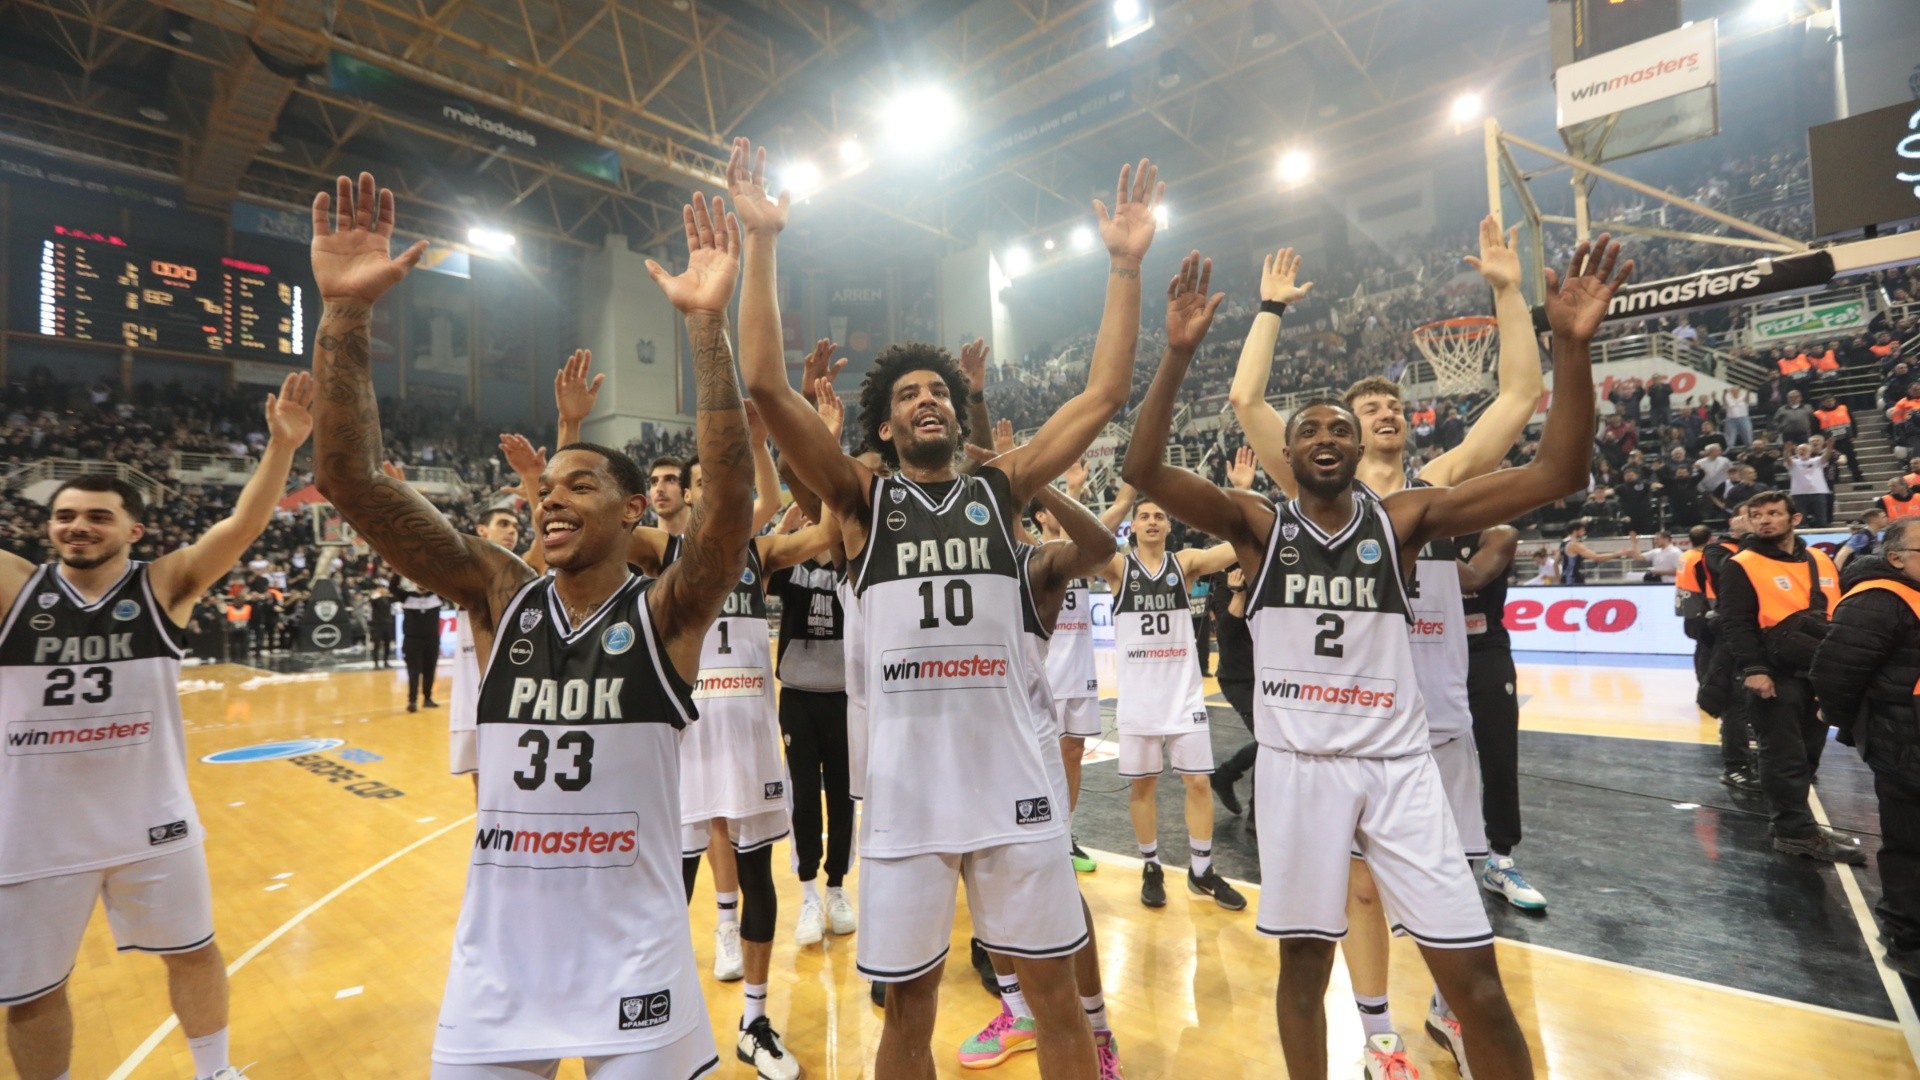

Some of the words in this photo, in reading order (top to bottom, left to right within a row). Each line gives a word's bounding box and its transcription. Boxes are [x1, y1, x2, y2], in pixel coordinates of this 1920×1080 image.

[1571, 52, 1699, 102] winmasters
[1606, 268, 1761, 316] nmasters
[897, 537, 991, 576] PAOK
[722, 591, 752, 615] OK
[918, 579, 974, 629] 10
[1060, 590, 1077, 611] 9
[1133, 593, 1176, 611] PAOK
[1284, 573, 1378, 608] PAOK
[717, 621, 732, 655] 1
[1140, 613, 1170, 636] 20
[1314, 612, 1345, 659] 2
[34, 632, 134, 663] PAOK
[1128, 647, 1187, 659] winmasters
[694, 673, 764, 691] nmasters
[883, 654, 1007, 681] winmasters
[43, 666, 113, 706] 23
[508, 677, 625, 721] PAOK
[1262, 678, 1395, 708] winmasters
[8, 721, 150, 746] winmasters
[513, 728, 595, 791] 33
[475, 822, 636, 854] winmasters
